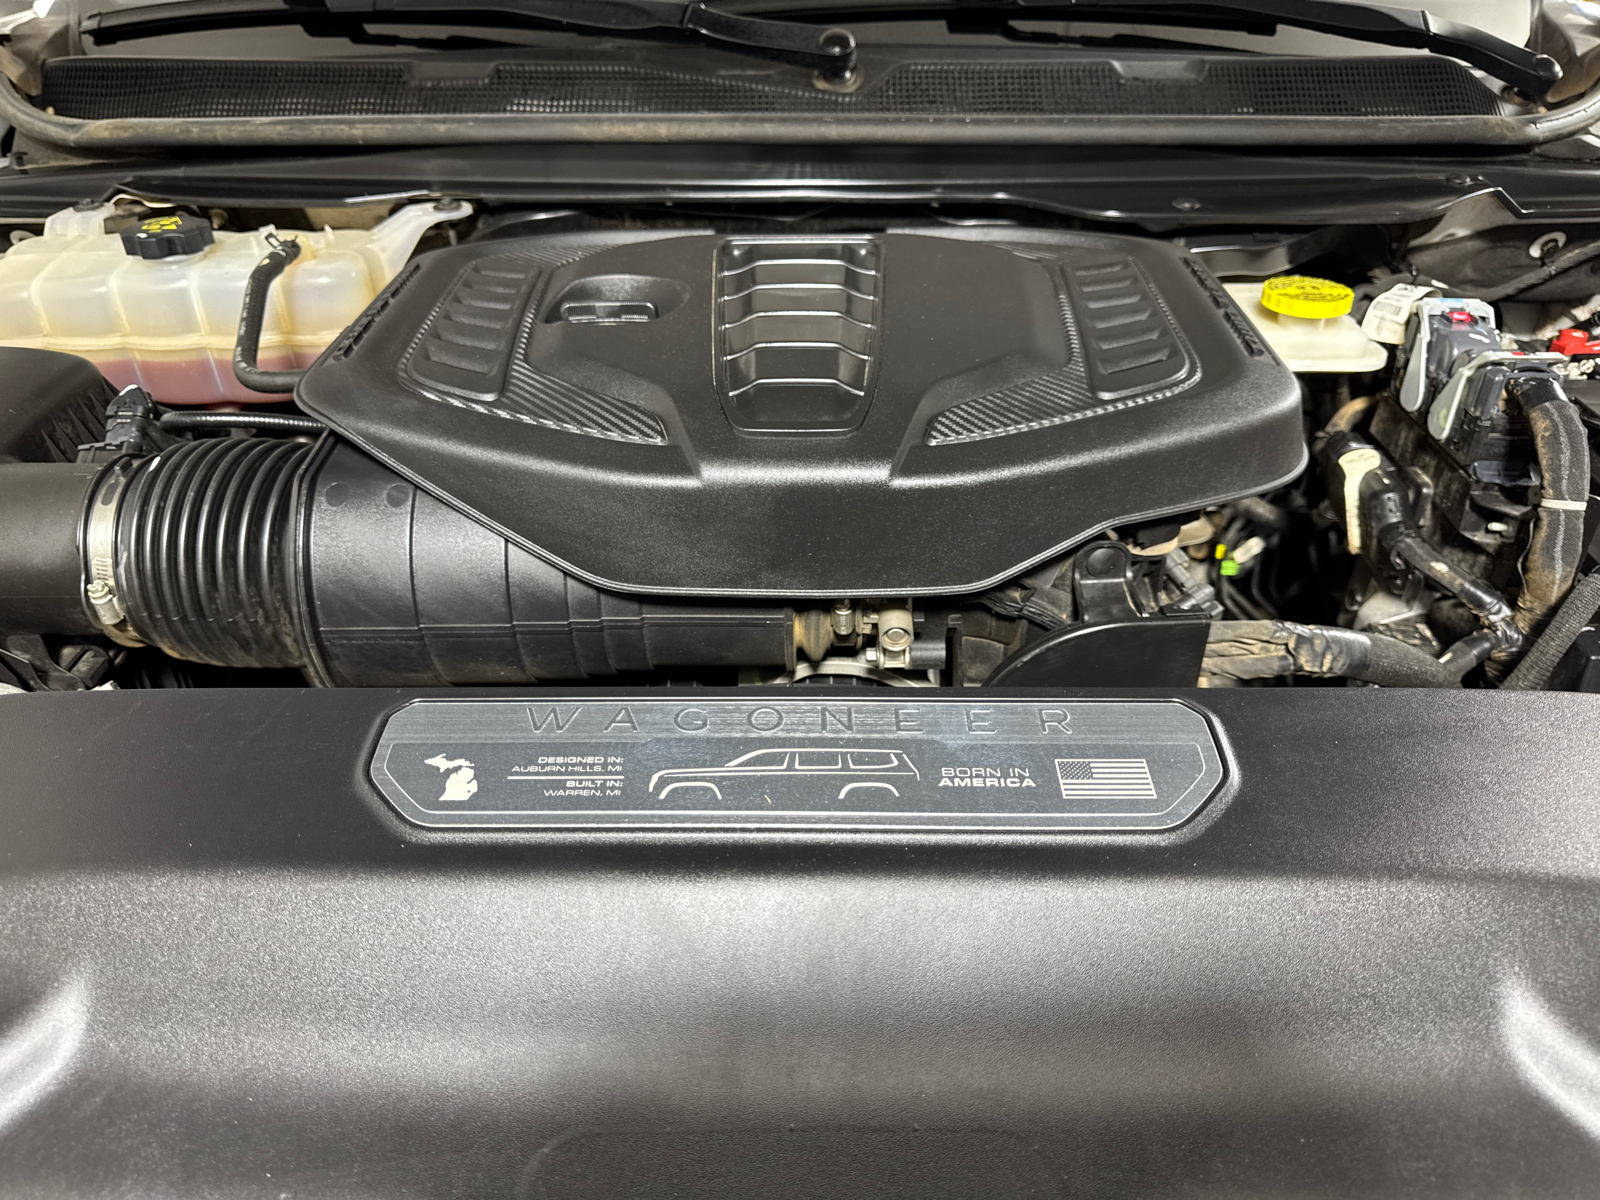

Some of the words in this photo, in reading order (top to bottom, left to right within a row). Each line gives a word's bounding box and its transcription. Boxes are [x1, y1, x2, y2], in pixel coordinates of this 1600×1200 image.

[526, 706, 1073, 733] WAGONEER
[537, 756, 604, 764] DESIGNED
[607, 756, 624, 764] IN:
[511, 764, 565, 772] AUBURN
[607, 764, 622, 772] MI
[941, 767, 1001, 776] BORN
[1009, 767, 1030, 776] IN
[938, 777, 1037, 787] AMERICA
